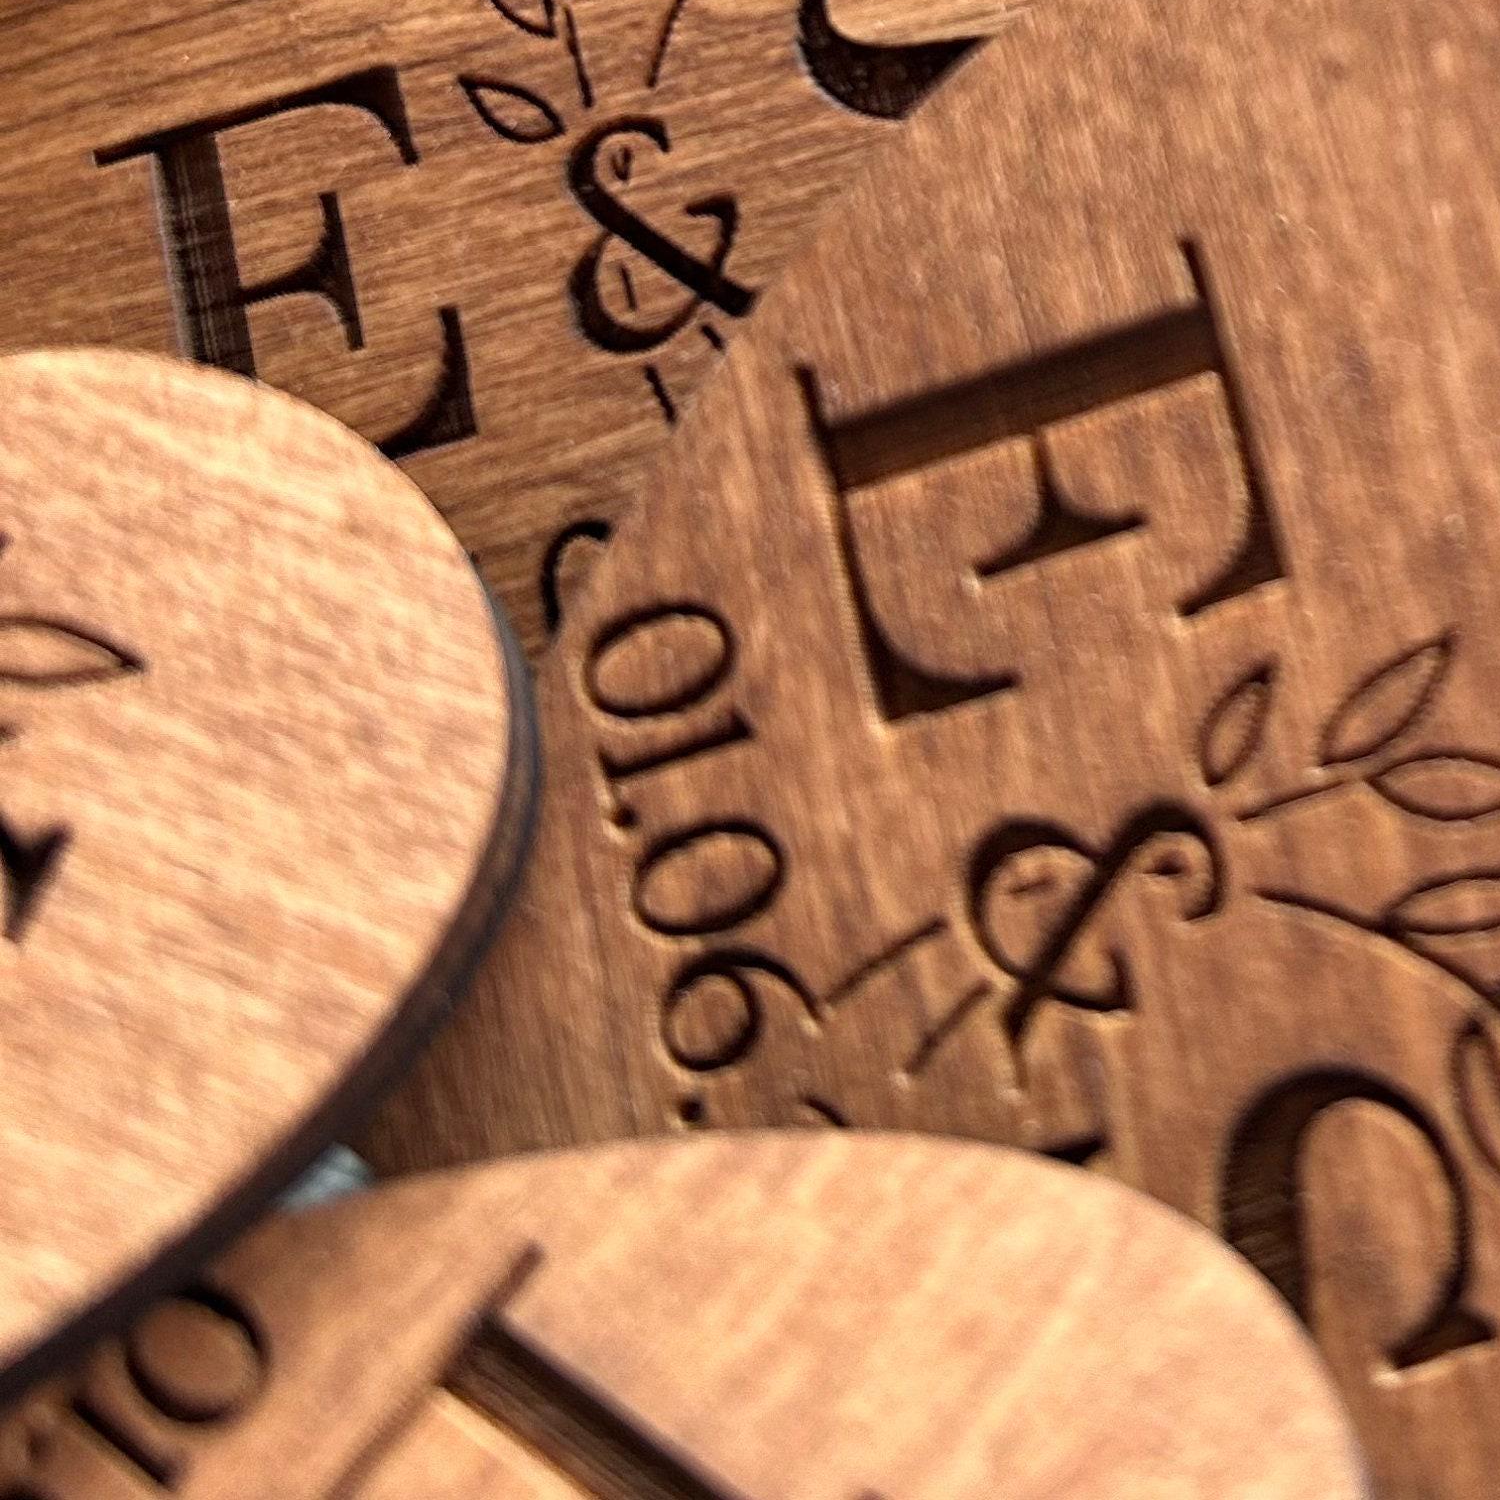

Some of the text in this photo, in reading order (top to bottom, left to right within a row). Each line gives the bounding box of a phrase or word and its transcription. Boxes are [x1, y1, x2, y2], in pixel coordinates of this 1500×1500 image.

[94, 63, 478, 458] E
[567, 115, 760, 354] &
[794, 235, 1290, 727] E
[582, 602, 852, 1128] 01.06.
[964, 795, 1227, 1090] &
